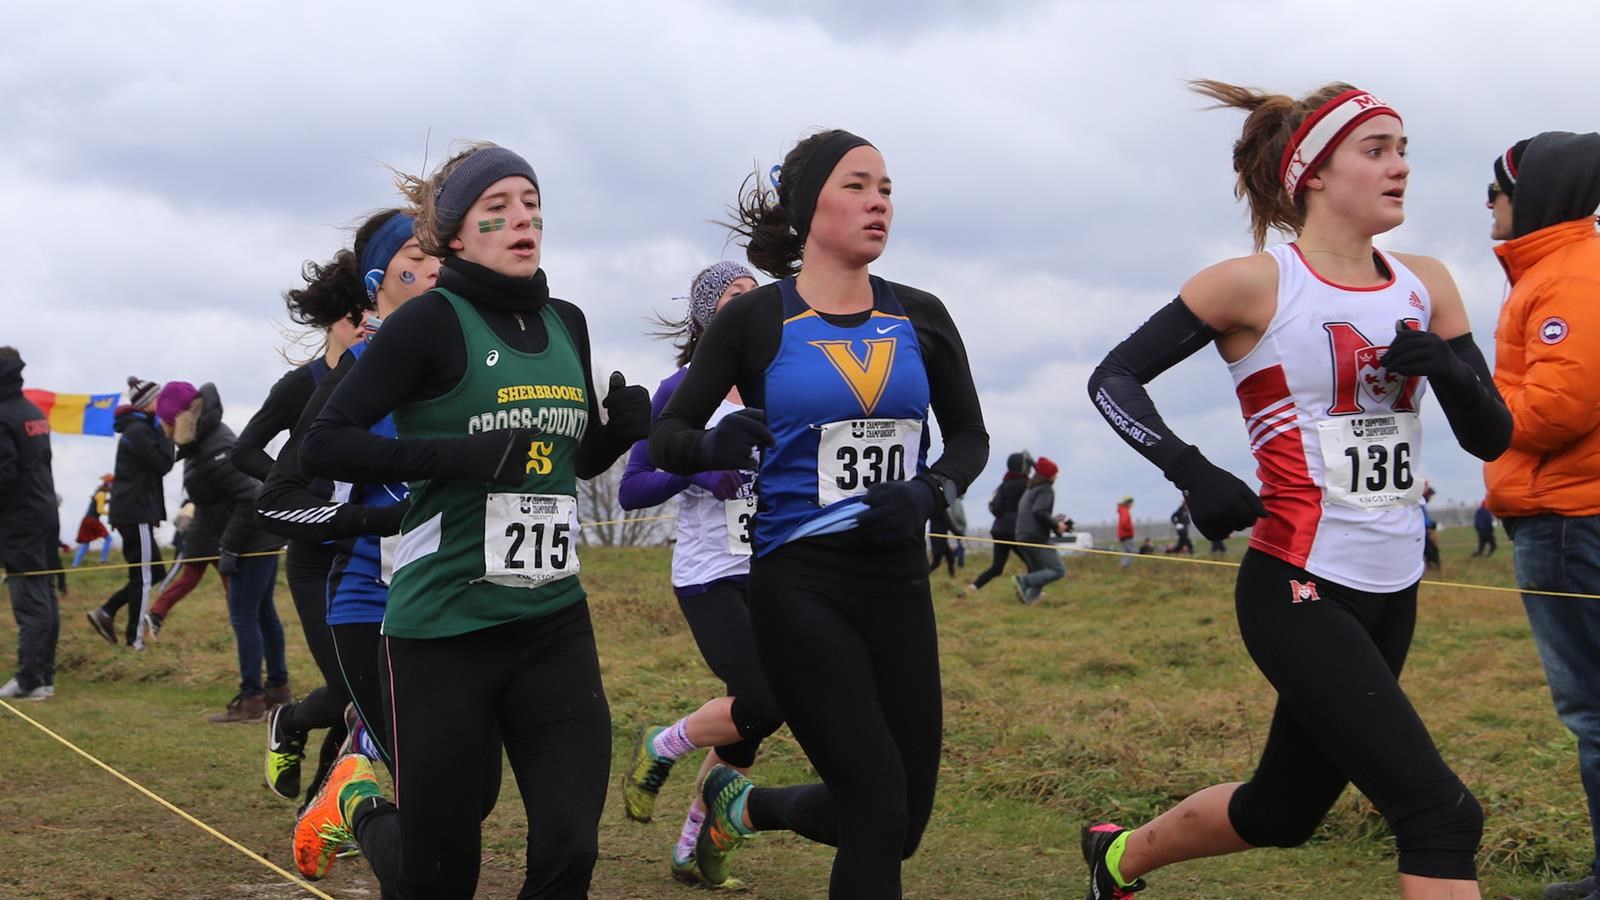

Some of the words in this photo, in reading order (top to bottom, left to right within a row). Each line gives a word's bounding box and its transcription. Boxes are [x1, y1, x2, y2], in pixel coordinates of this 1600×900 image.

[497, 384, 585, 404] SHERBROOKE
[808, 337, 897, 416] V
[468, 407, 589, 440] CROSS-COUNT
[526, 441, 554, 475] S
[836, 444, 905, 490] 330
[1344, 442, 1414, 493] 136
[504, 522, 570, 569] 215
